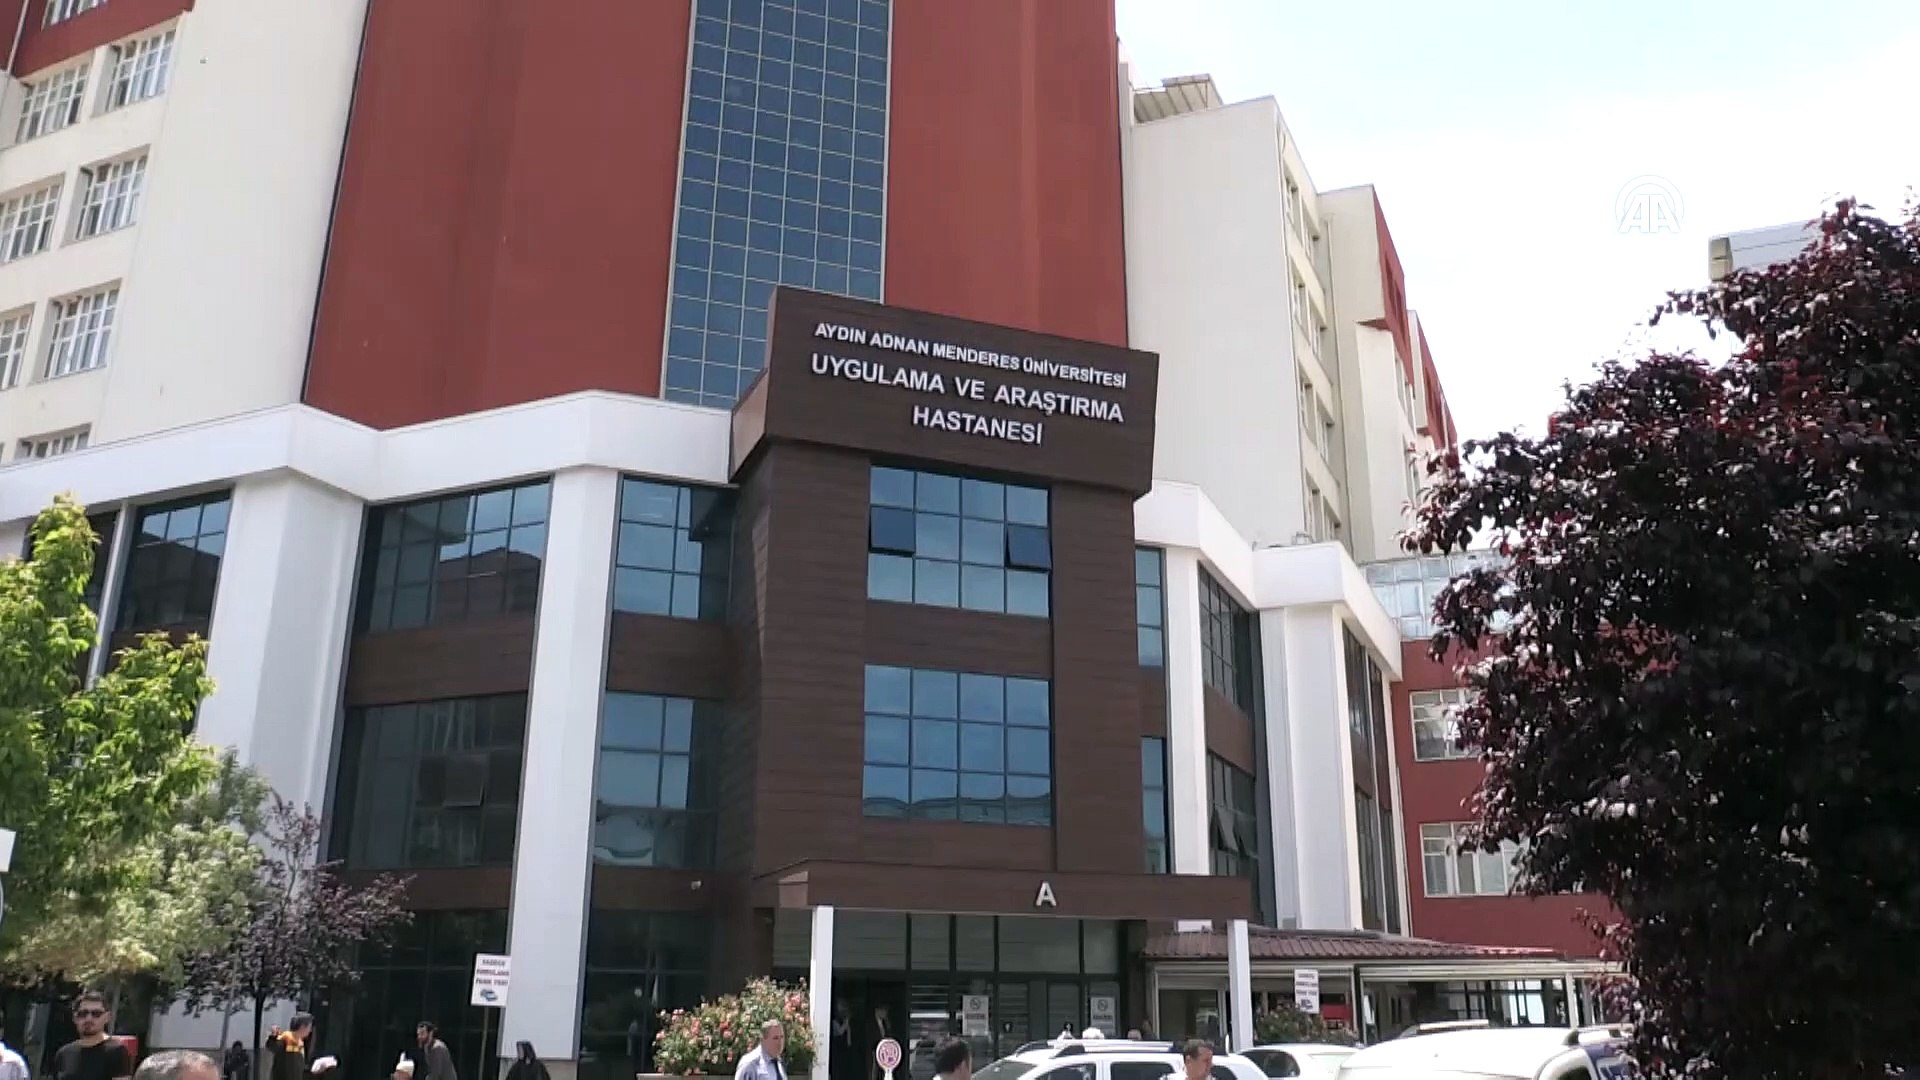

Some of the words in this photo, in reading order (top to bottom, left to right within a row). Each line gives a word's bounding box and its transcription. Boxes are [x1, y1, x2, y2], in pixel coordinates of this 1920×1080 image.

[815, 323, 866, 343] AYDIN
[869, 333, 928, 354] ADNAN
[932, 343, 1019, 369] MENDERES
[1022, 357, 1126, 388] ÜNİVERSİTESİ
[812, 354, 944, 393] UYGULAMA
[954, 377, 984, 399] VE
[994, 385, 1123, 421] ARAŞTIRMA
[913, 406, 1042, 443] HASTANESİ
[1036, 882, 1057, 906] A
